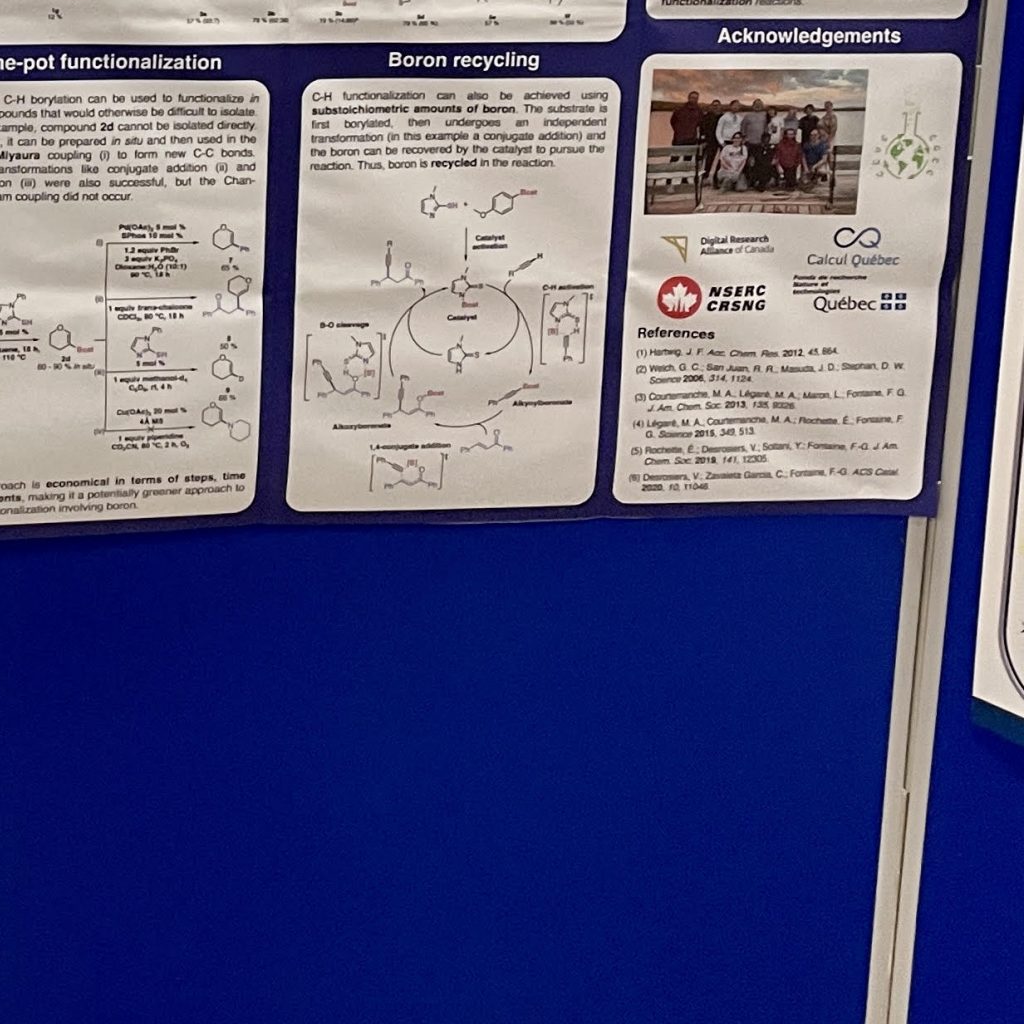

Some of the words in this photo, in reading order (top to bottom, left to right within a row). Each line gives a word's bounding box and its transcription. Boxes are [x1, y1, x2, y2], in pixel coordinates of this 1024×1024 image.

[717, 27, 904, 47] Acknowledgements
[60, 53, 222, 70] functionalization
[388, 51, 448, 68] Boron
[453, 51, 541, 71] recycling
[3, 94, 26, 105] C-H
[30, 95, 83, 107] borylation
[87, 95, 108, 104] can
[112, 93, 126, 104] be
[130, 93, 158, 103] used
[162, 93, 174, 103] to
[178, 93, 245, 103] functionalize
[249, 94, 260, 103] in
[311, 104, 411, 115] substoichiometric
[413, 104, 463, 113] amounts
[466, 103, 480, 114] of
[521, 103, 544, 114] The
[547, 104, 596, 113] substrate
[599, 105, 609, 113] is
[700, 236, 728, 246] Digital
[729, 234, 770, 244] Research
[700, 246, 733, 256] Alliance
[735, 245, 744, 254] of
[745, 245, 775, 253] Canada
[807, 253, 849, 266] Calcul
[850, 253, 901, 268] Québec
[708, 284, 768, 297] NSERC
[706, 299, 767, 312] CRSNG
[813, 295, 878, 313] Québec
[637, 326, 716, 339] References
[31, 481, 41, 489] is
[46, 477, 111, 488] economical
[115, 477, 126, 485] in
[131, 476, 163, 485] terms
[168, 473, 180, 484] of
[223, 472, 247, 481] time
